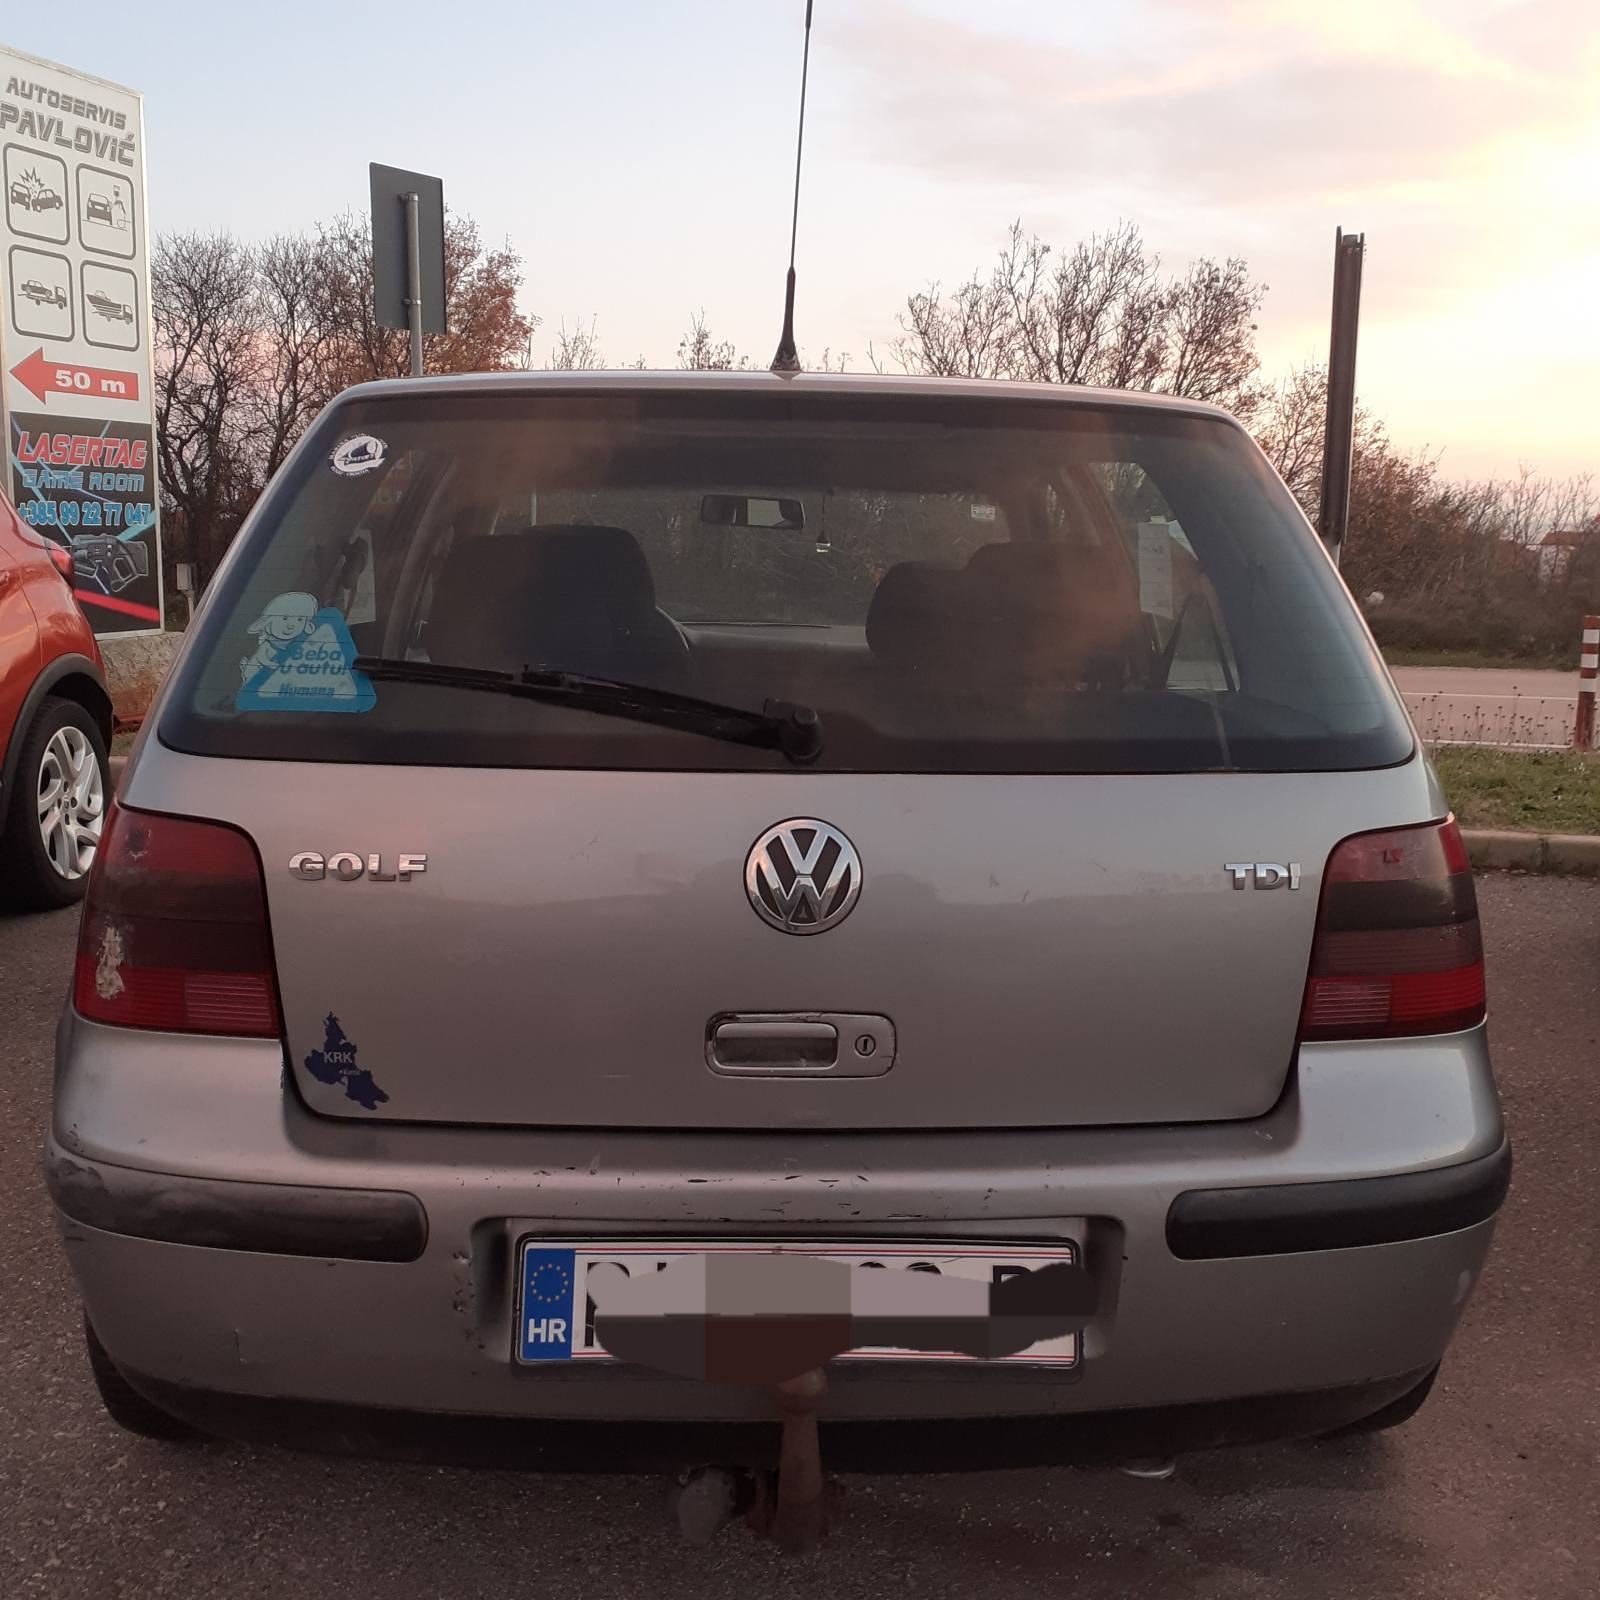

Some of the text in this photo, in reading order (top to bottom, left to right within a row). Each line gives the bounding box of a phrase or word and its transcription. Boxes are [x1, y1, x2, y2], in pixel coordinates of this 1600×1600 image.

[6, 77, 127, 131] AUTOSERVIS
[55, 369, 126, 394] 50 m
[17, 431, 148, 470] LASERTAG
[22, 468, 145, 492] GAME ROOM
[18, 500, 151, 527] +385 99 22 77 047
[290, 643, 341, 661] Beba
[288, 851, 428, 882] GOLF
[1224, 862, 1301, 890] TDI
[323, 1051, 353, 1063] KRK
[527, 1317, 567, 1344] HR
